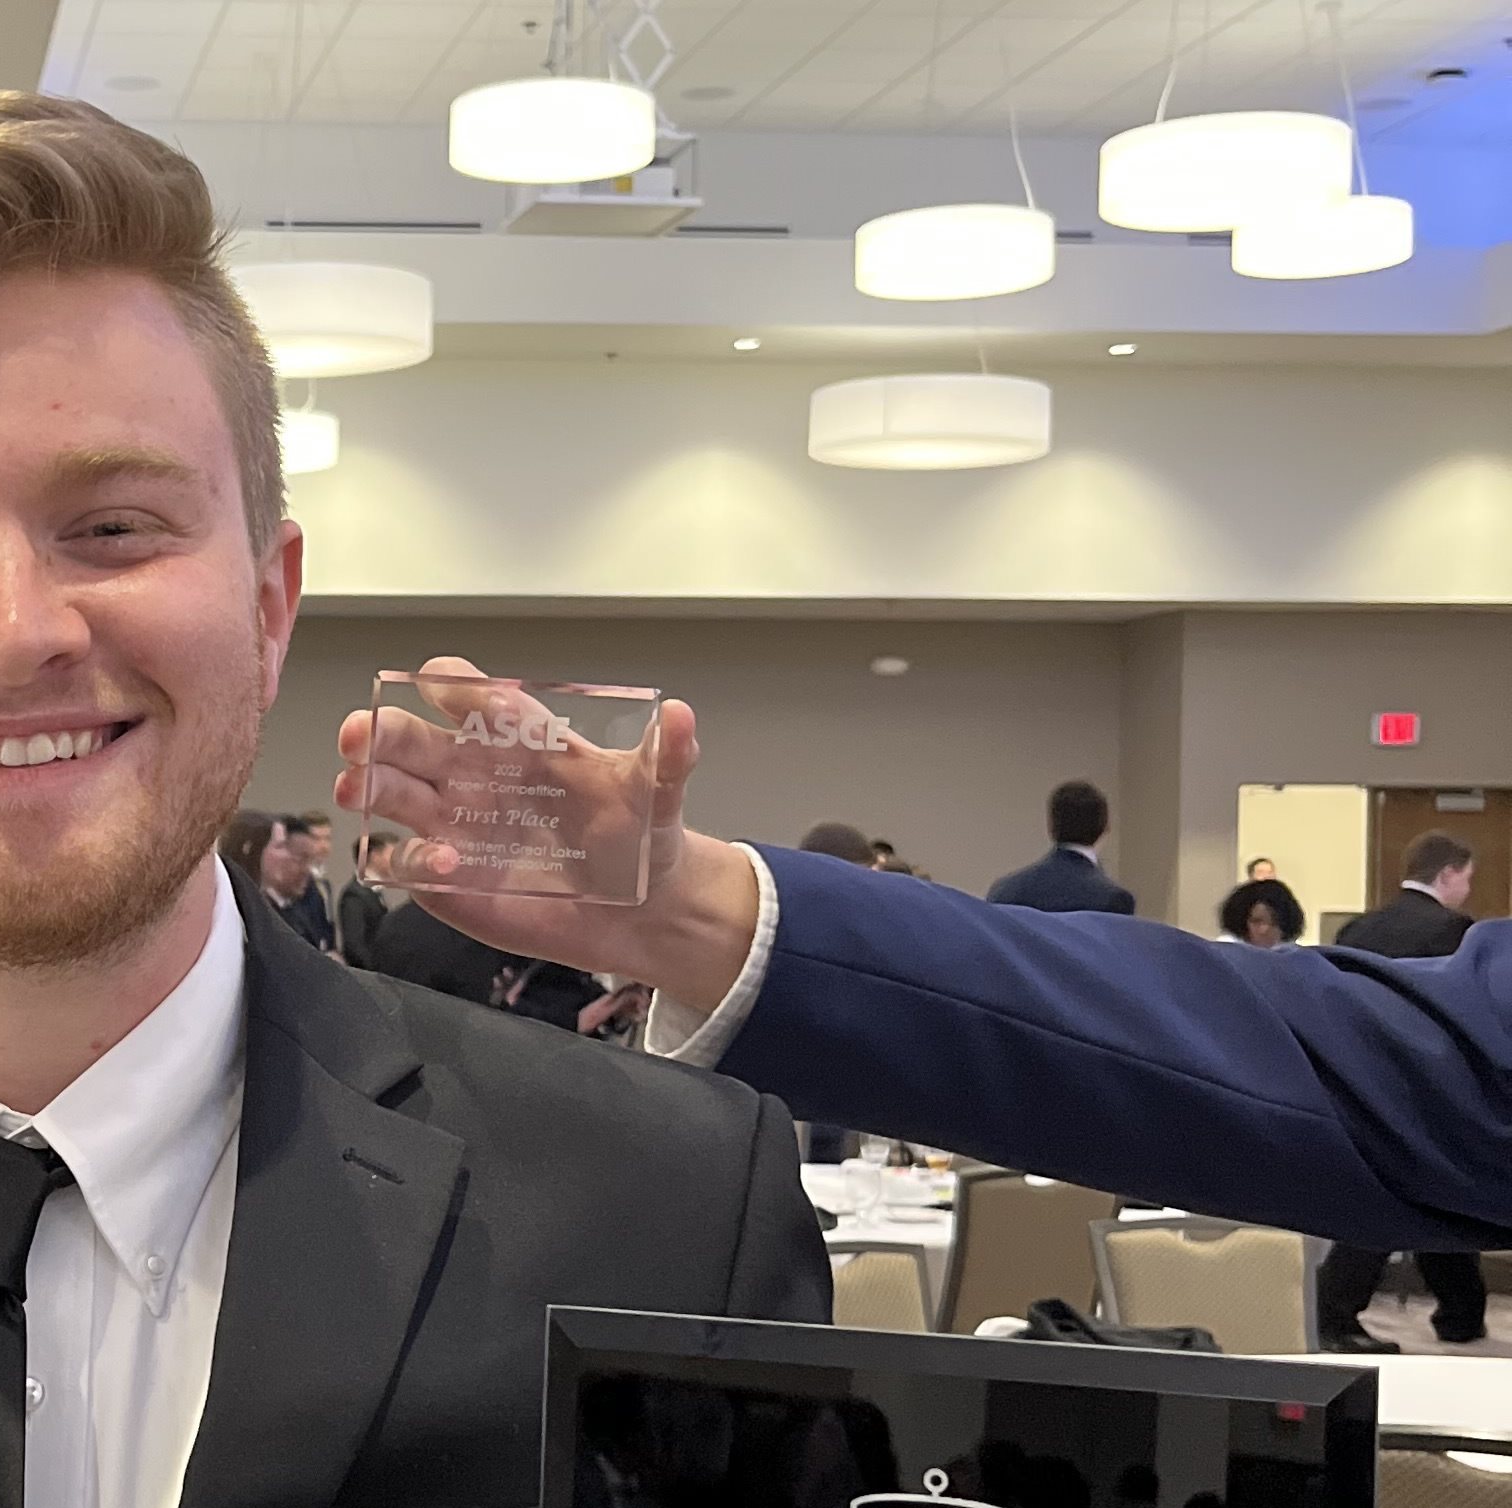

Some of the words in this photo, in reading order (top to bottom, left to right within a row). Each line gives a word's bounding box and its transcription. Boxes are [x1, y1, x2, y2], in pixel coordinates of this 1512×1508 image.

[454, 710, 570, 751] ASCE
[494, 763, 522, 777] 2022
[448, 778, 484, 795] Paper
[488, 781, 566, 798] Competition
[450, 806, 499, 825] First
[506, 808, 560, 829] Place
[457, 839, 506, 854] Western
[511, 842, 546, 857] Great
[550, 847, 587, 860] Lakes
